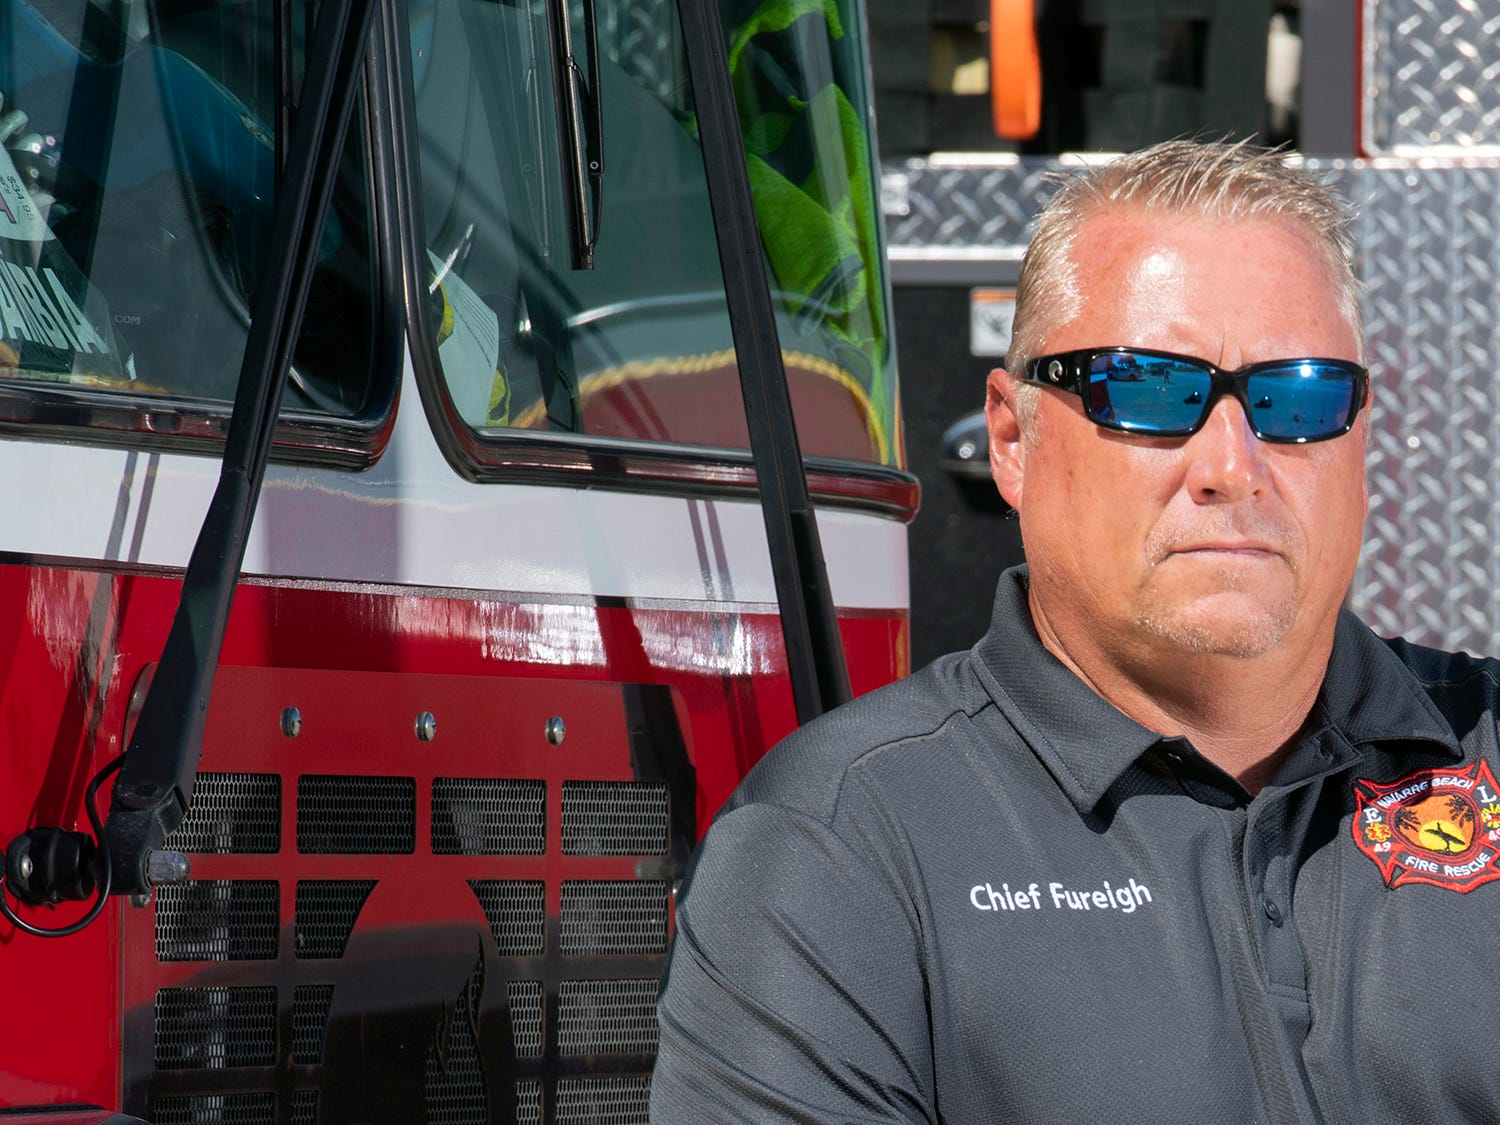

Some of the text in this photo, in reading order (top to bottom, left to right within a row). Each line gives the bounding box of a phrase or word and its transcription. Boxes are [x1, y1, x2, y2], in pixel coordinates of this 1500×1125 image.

[1376, 777, 1475, 809] NAVARRE BEACH
[1477, 785, 1498, 804] L
[1363, 807, 1383, 824] E
[1373, 842, 1392, 853] 49
[1404, 852, 1492, 877] FIRE RESCUE
[969, 878, 1153, 914] Chief Fureigh
